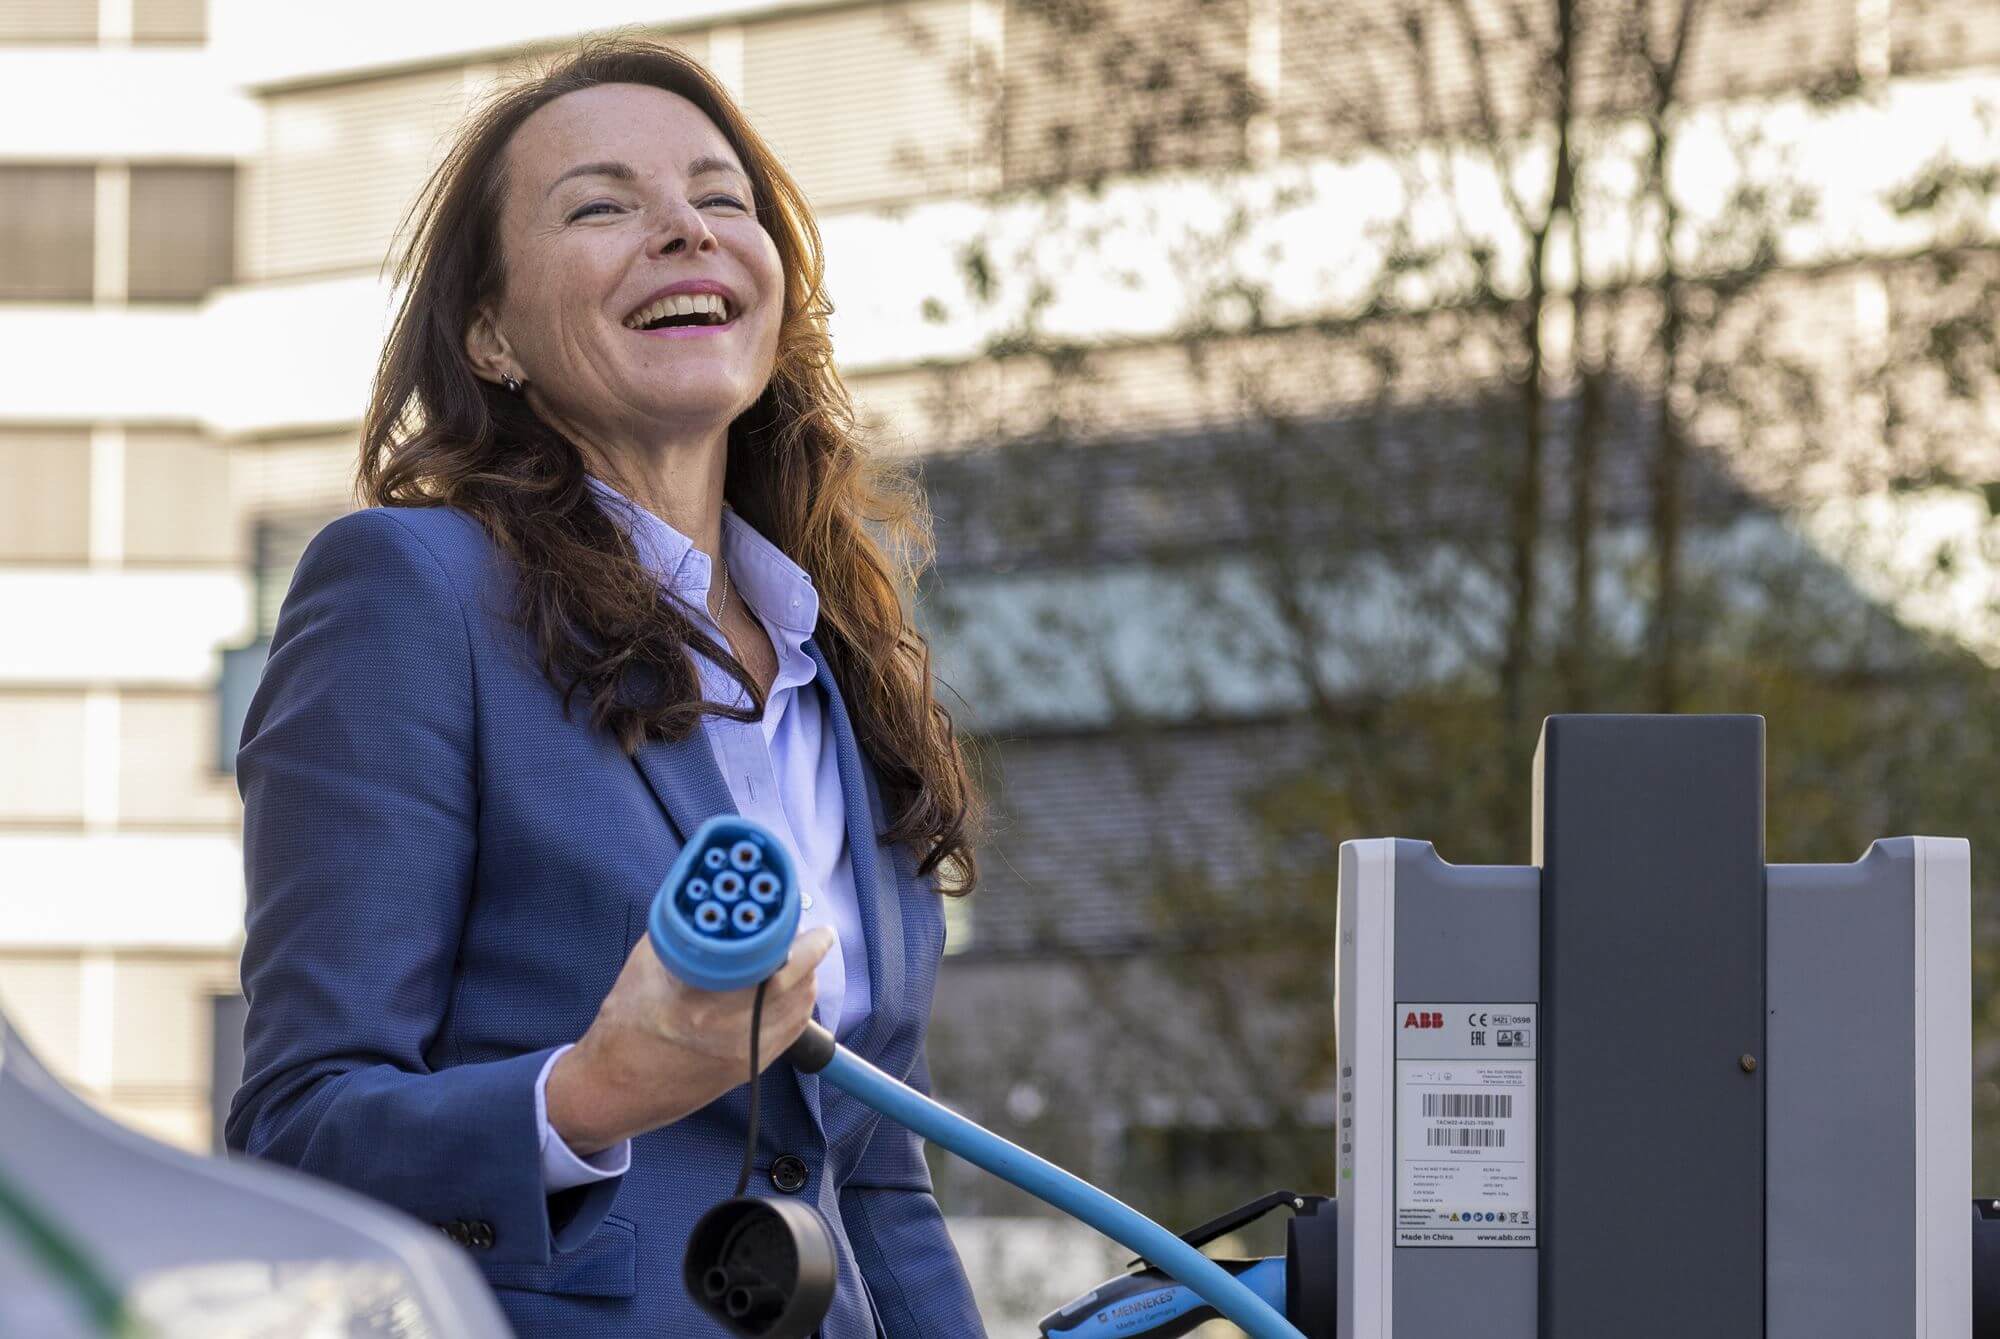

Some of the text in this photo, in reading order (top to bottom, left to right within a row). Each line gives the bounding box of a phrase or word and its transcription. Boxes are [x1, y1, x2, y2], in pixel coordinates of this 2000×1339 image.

[1404, 1012, 1444, 1028] ABB
[1401, 1233, 1454, 1241] Made in China
[1477, 1233, 1531, 1241] www.abb.com
